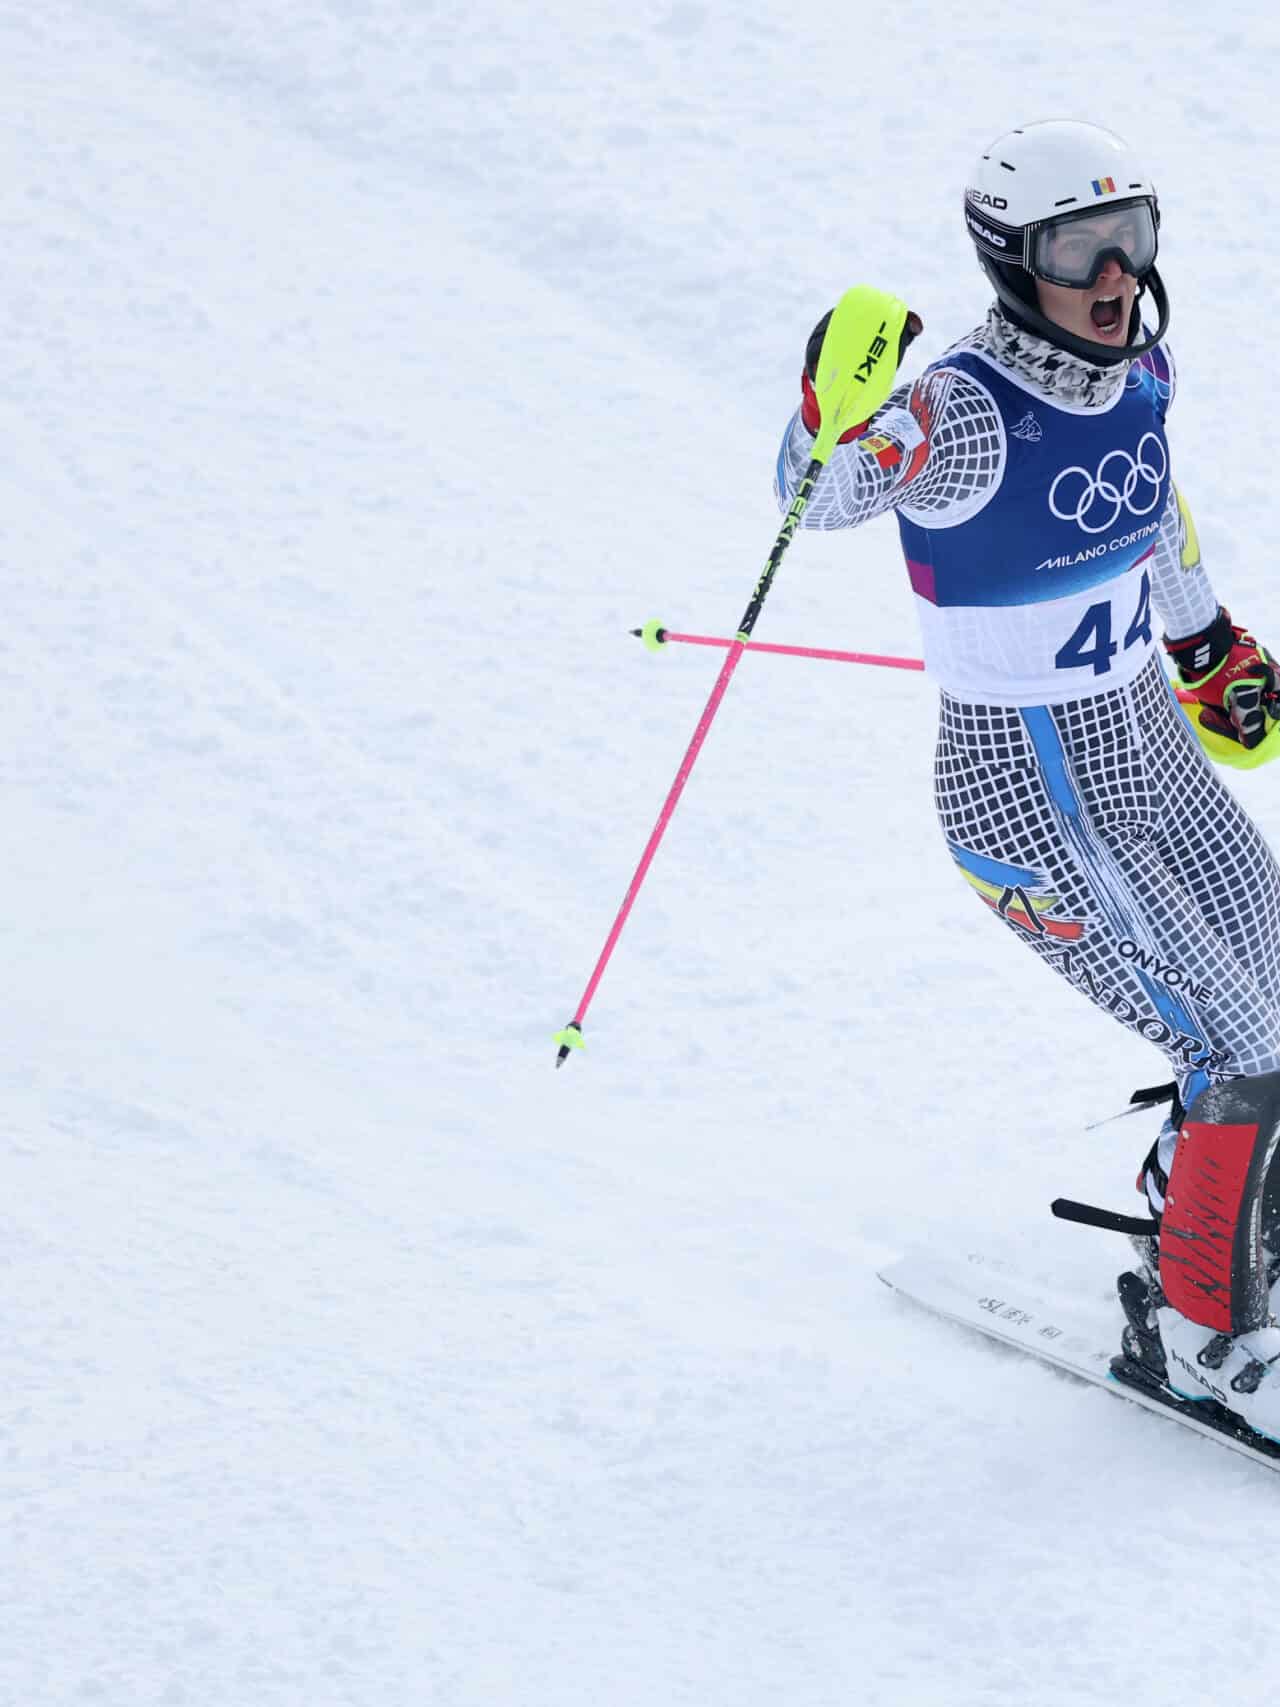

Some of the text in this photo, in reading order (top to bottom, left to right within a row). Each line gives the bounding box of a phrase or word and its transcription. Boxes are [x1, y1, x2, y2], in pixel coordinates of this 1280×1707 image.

[1035, 520, 1161, 571] MILANO CORTINA
[1055, 567, 1153, 677] 44
[1171, 1348, 1229, 1404] HEAD
